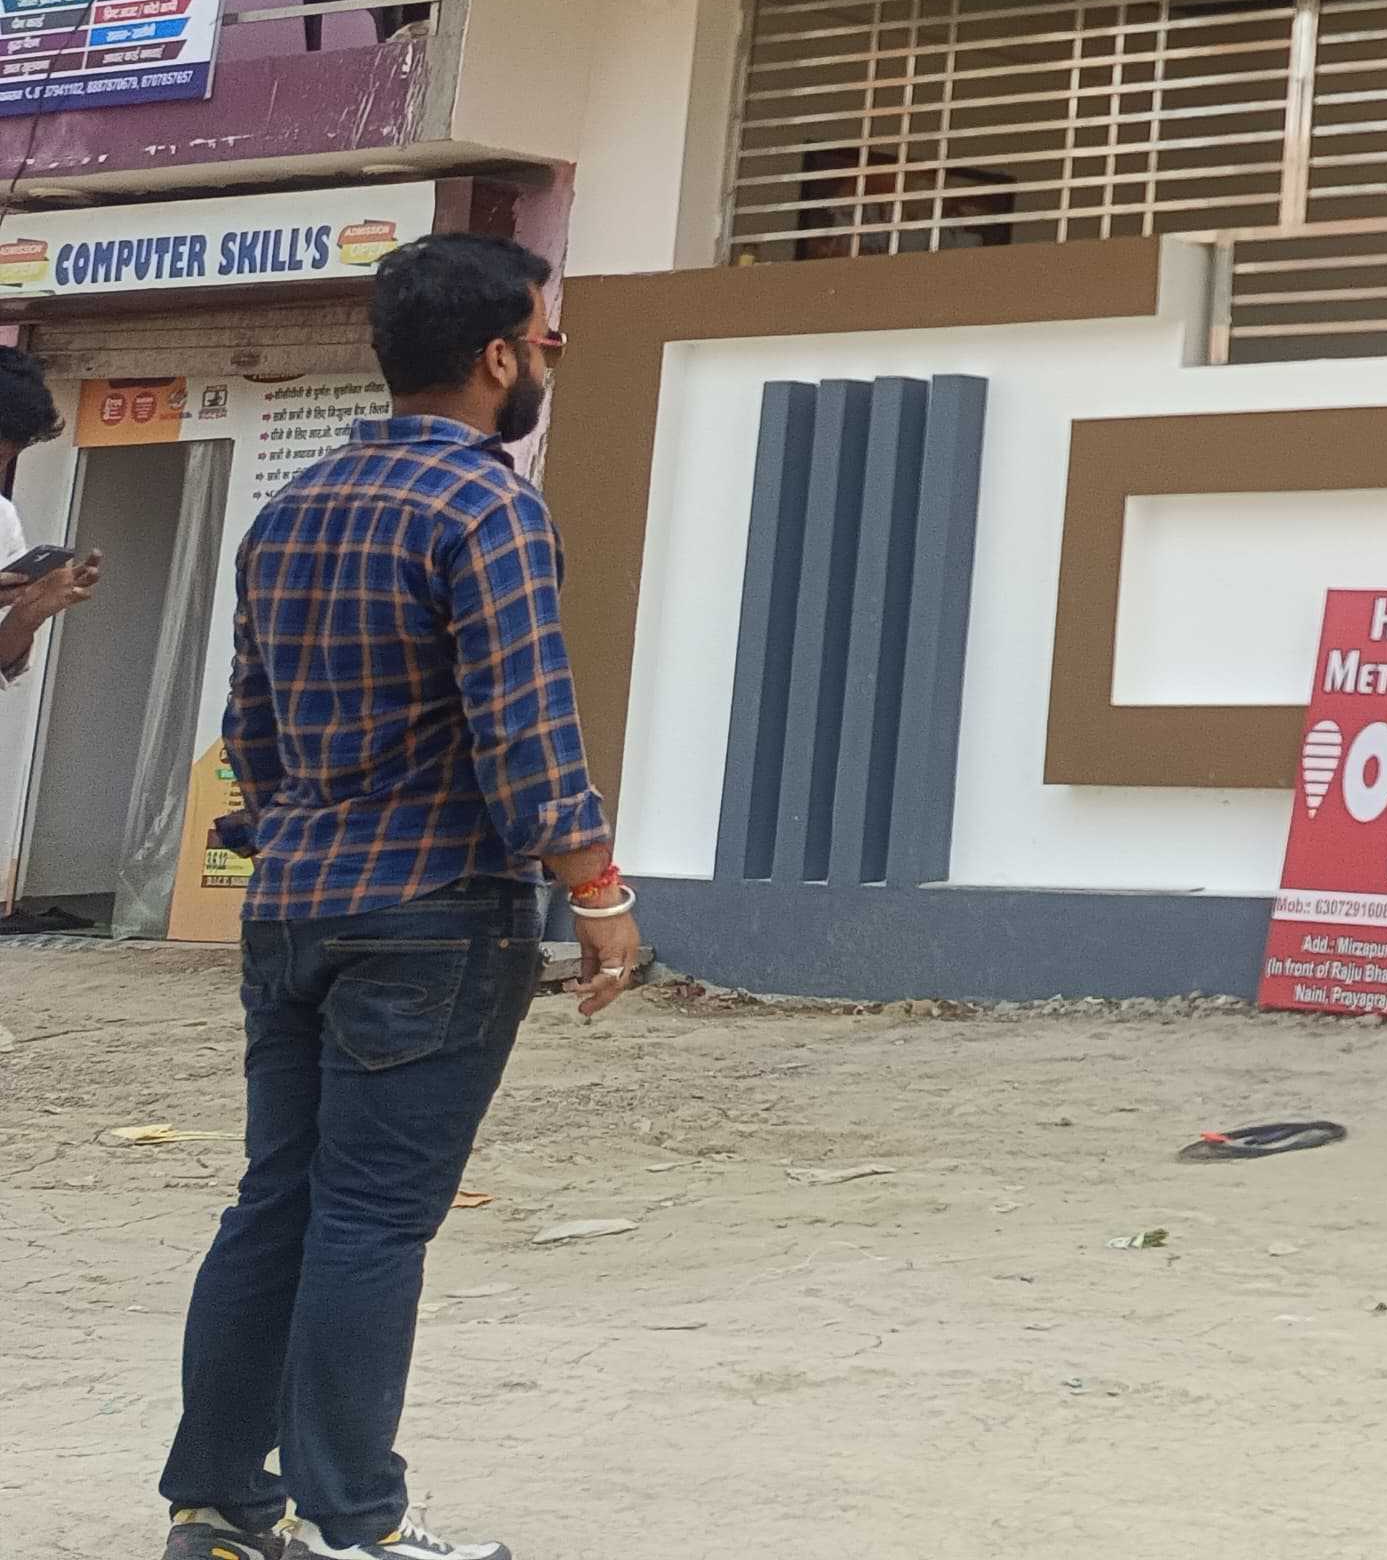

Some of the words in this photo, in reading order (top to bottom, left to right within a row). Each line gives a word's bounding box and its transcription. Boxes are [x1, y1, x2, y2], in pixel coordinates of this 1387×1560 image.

[55, 234, 207, 287] COMPUTER
[217, 225, 331, 276] SKILL'S
[1286, 959, 1315, 977] front
[1317, 960, 1331, 977] of
[1332, 960, 1361, 985] Rajju
